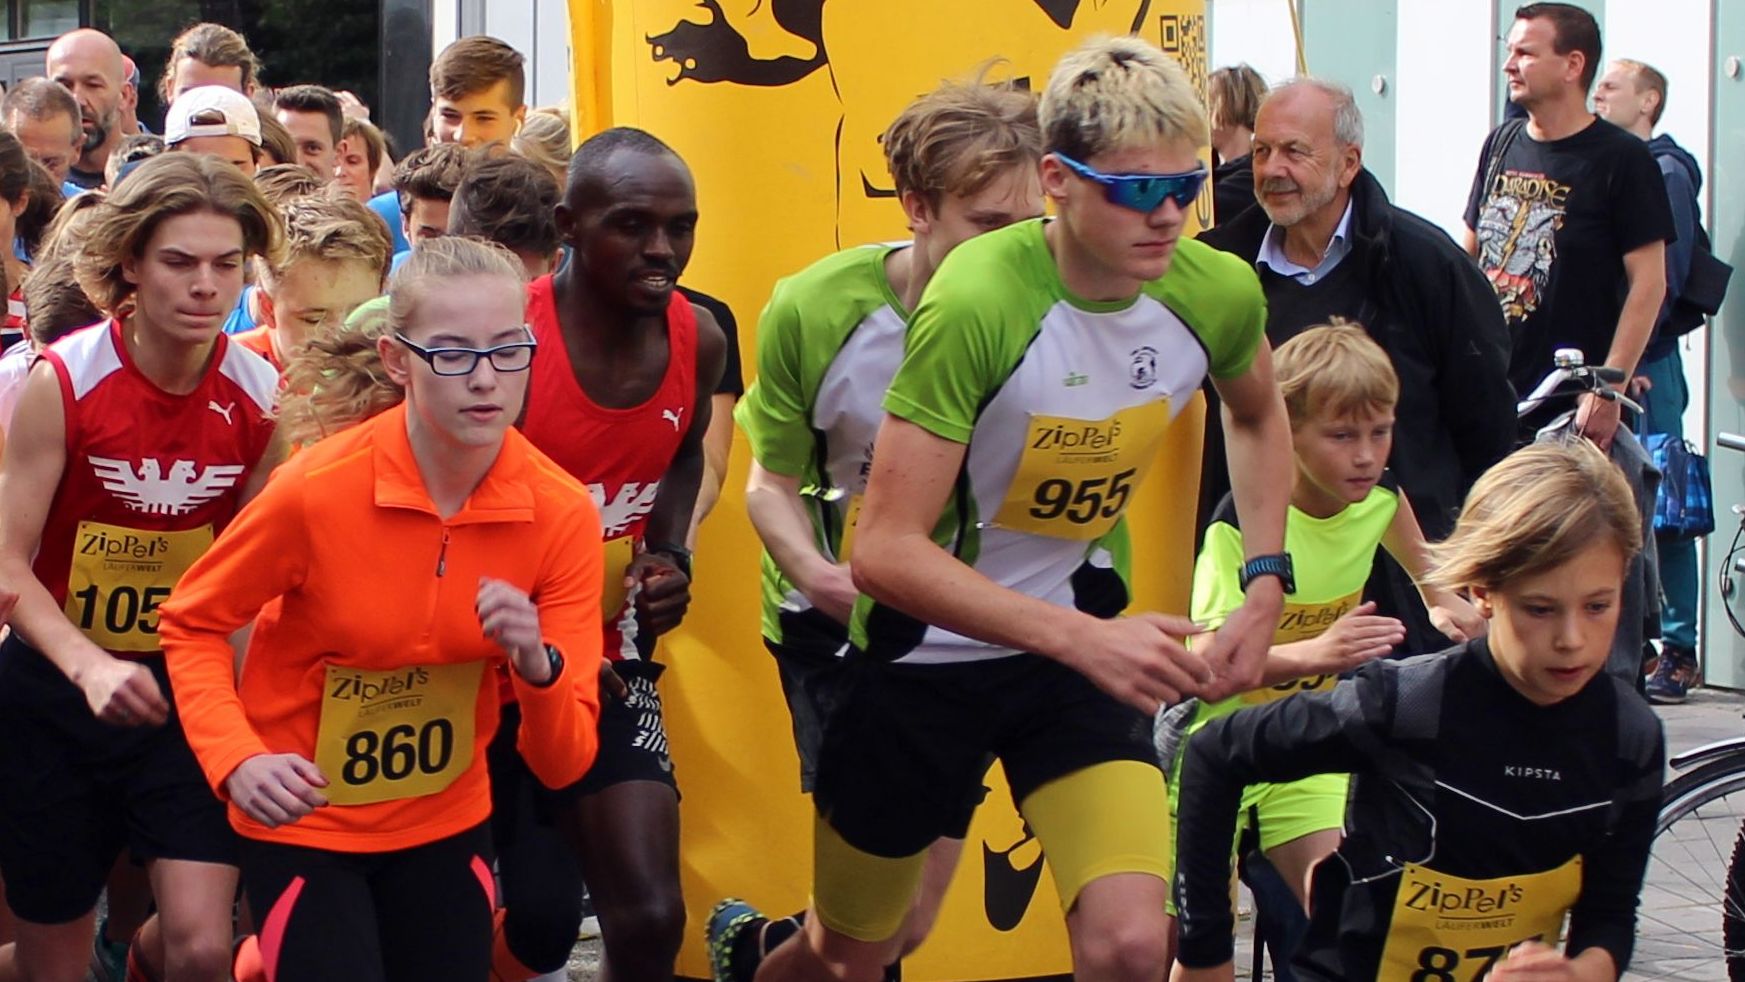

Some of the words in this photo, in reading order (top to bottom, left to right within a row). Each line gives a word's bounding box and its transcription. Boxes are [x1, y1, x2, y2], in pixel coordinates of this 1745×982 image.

[1029, 467, 1137, 524] 955
[342, 718, 454, 786] 860
[1504, 765, 1561, 780] KIPSTA
[1409, 933, 1543, 982] 87
